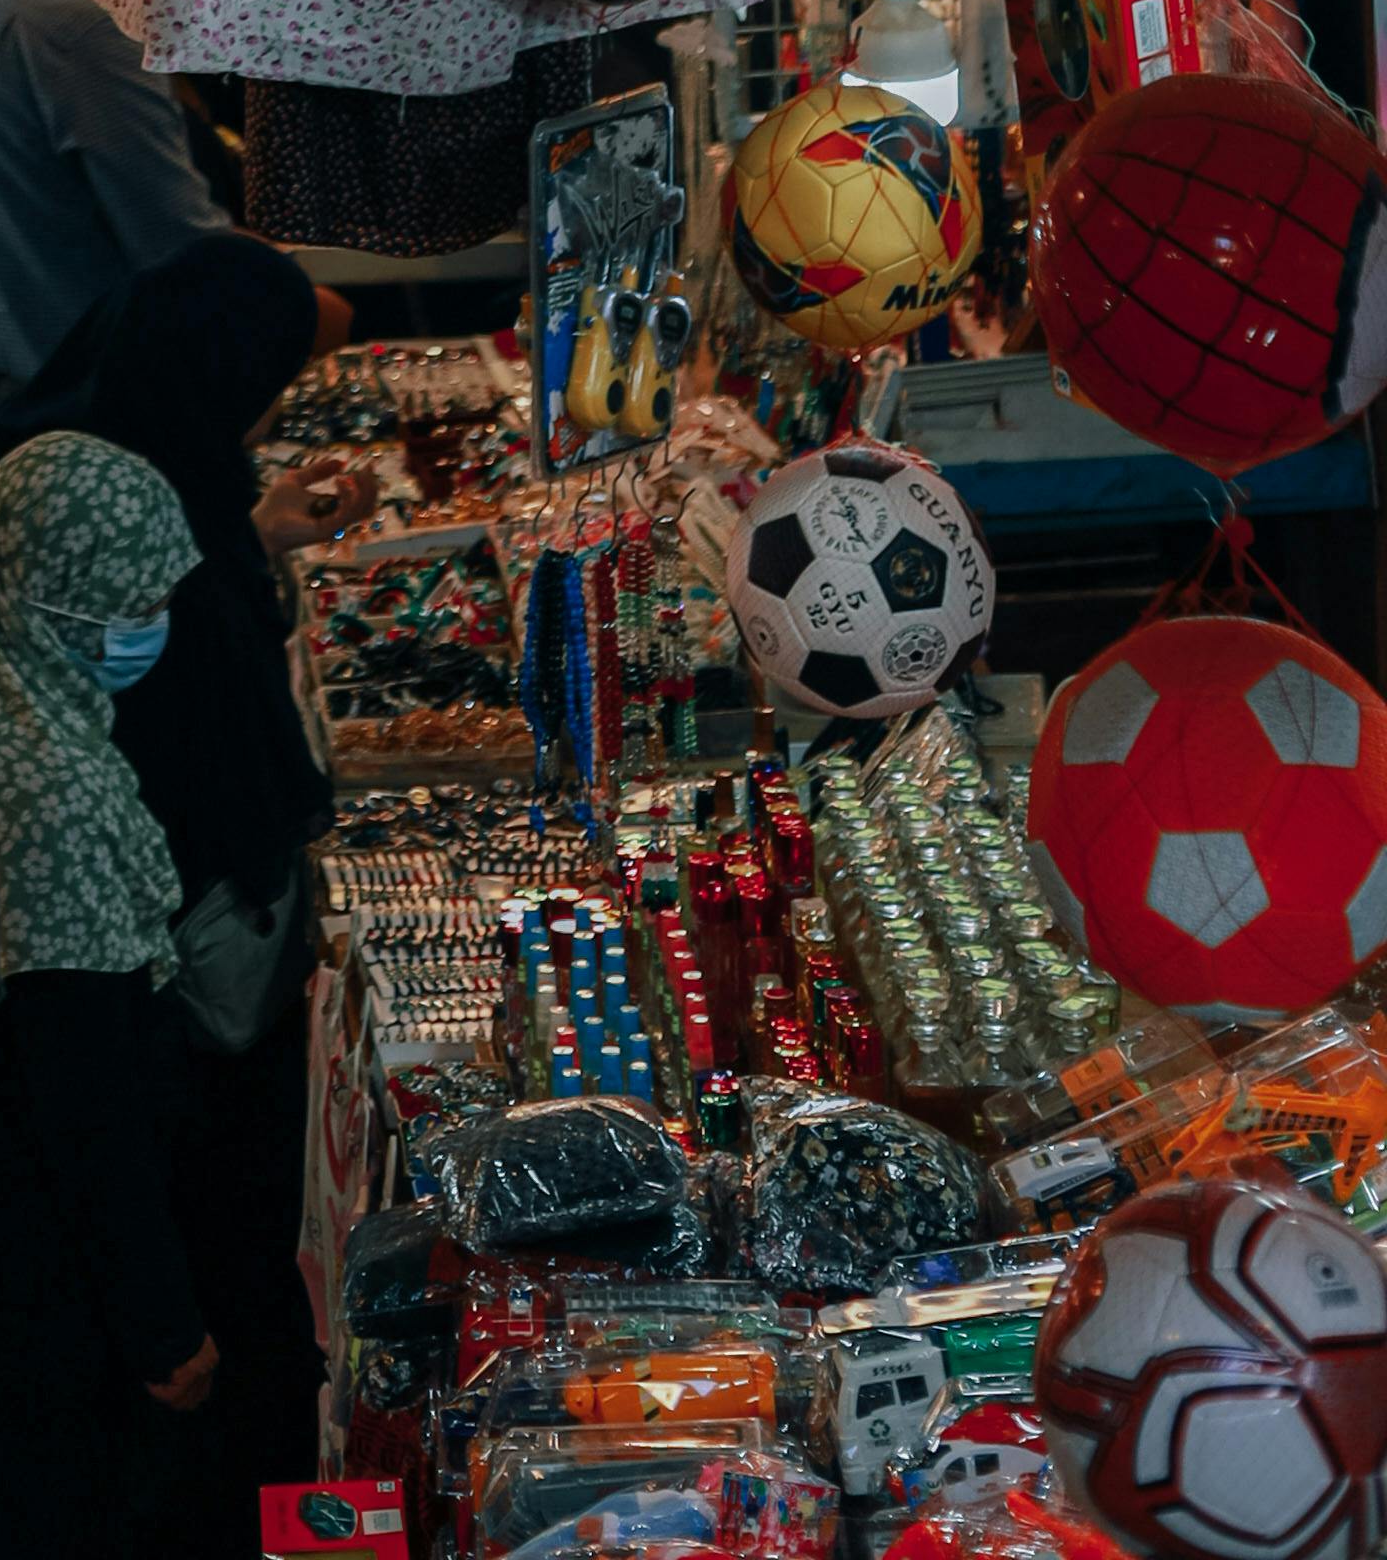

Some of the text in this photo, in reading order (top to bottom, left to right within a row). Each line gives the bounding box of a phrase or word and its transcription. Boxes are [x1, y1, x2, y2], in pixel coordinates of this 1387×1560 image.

[908, 482, 985, 619] GUANYU
[806, 602, 829, 629] 32
[819, 582, 854, 635] GYU
[846, 589, 867, 610] 5
